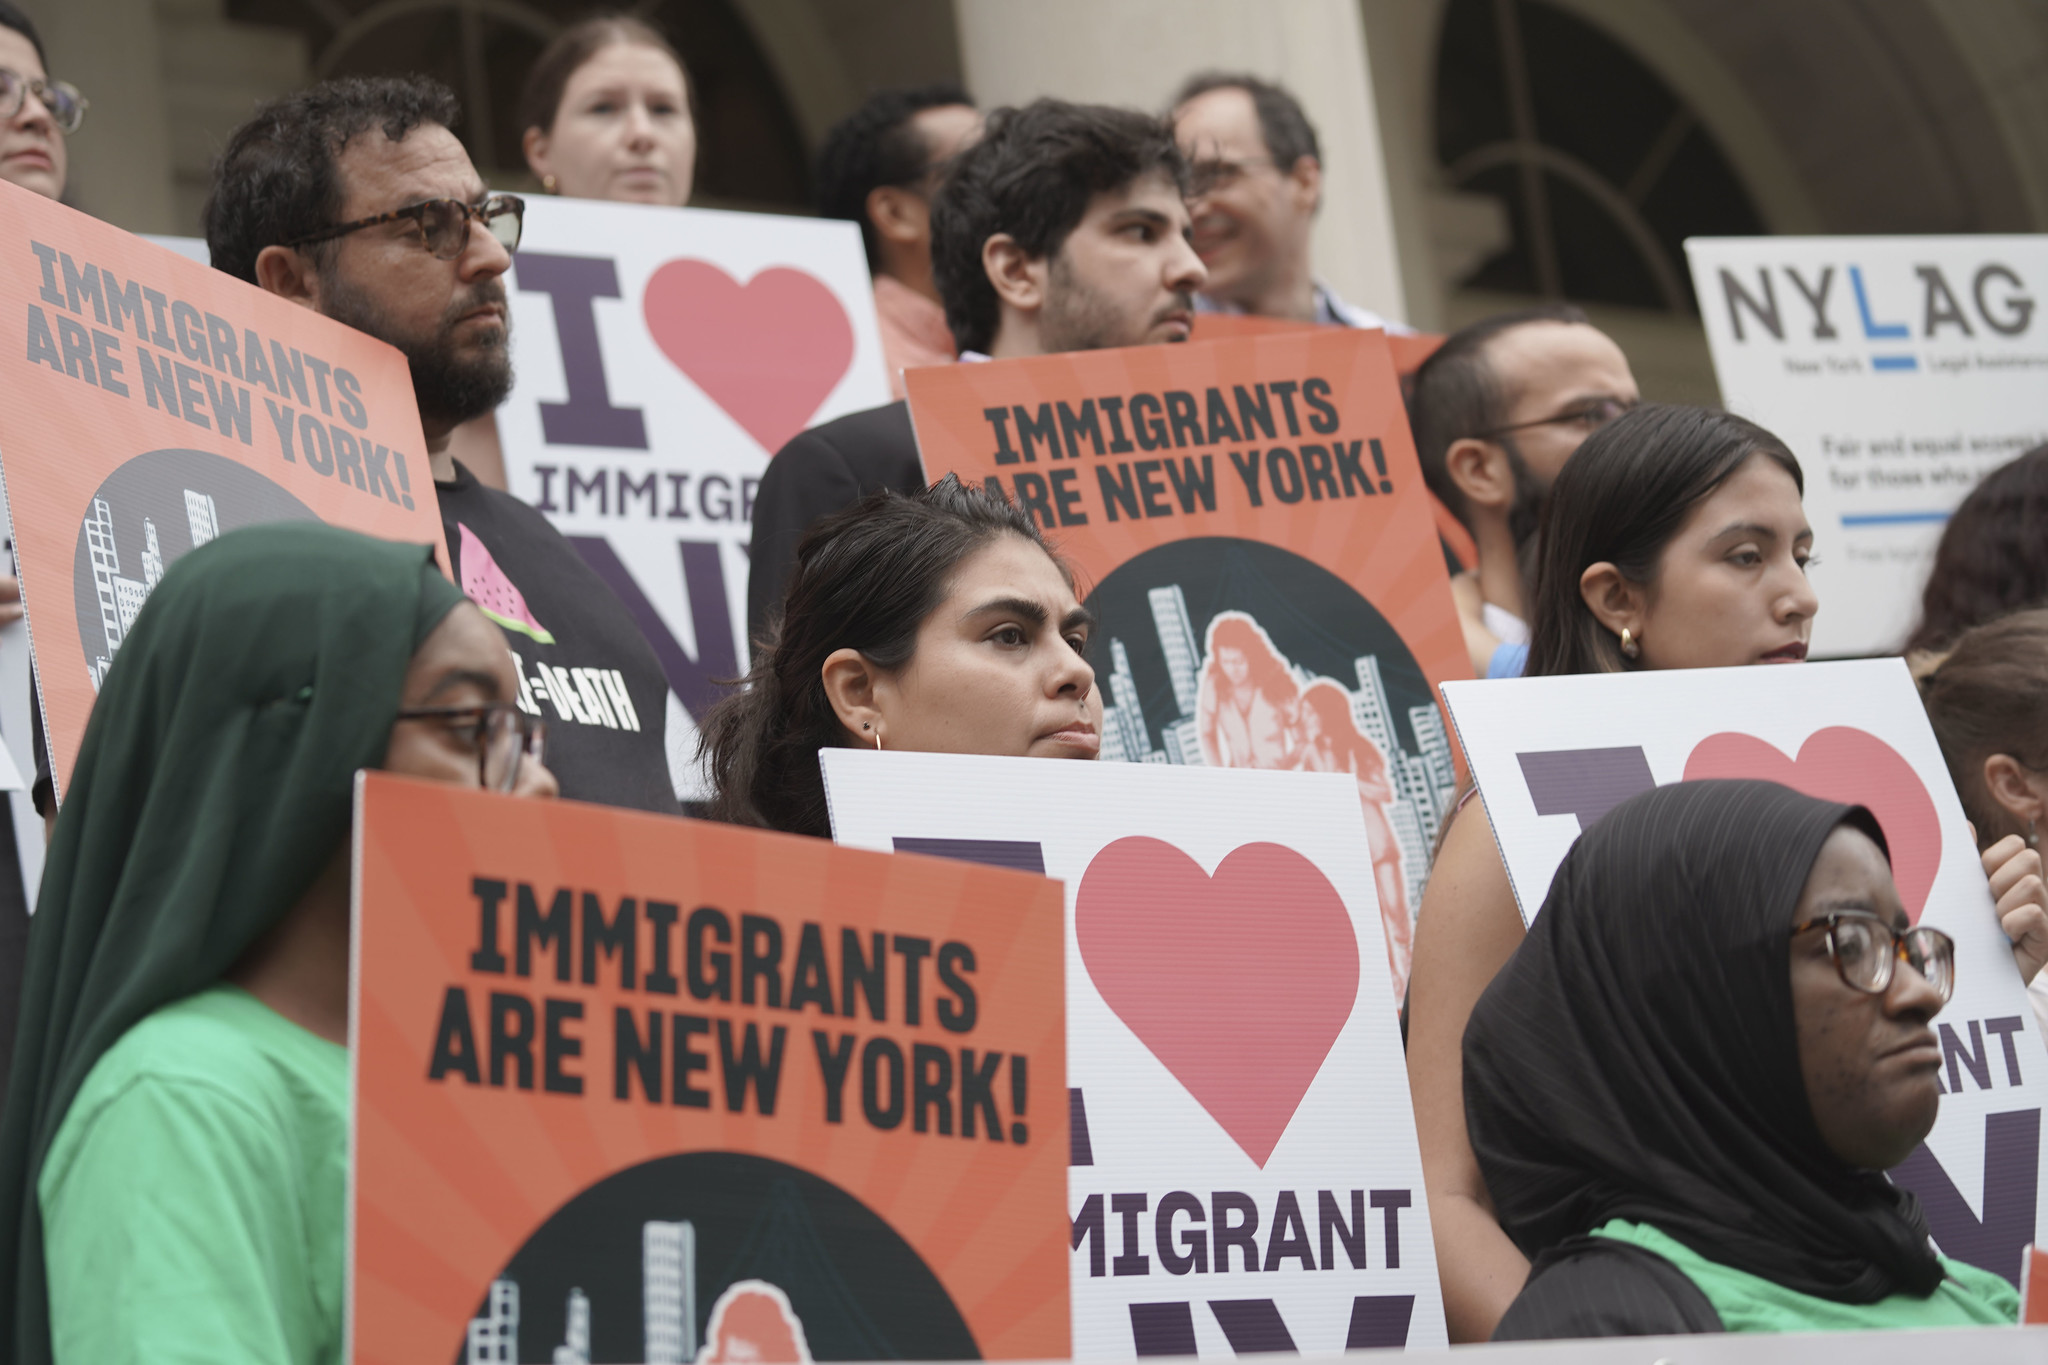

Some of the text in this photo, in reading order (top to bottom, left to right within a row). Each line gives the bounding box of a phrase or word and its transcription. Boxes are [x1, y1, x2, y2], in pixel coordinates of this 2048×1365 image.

[30, 240, 368, 430] IMMIGRANTS
[514, 251, 651, 451] I
[1717, 262, 2036, 343] NYLAG
[26, 304, 417, 512] ARE NEW YORK!
[983, 377, 1340, 466] IMMIGRANTS
[1095, 454, 1219, 523] NEW
[1227, 437, 1394, 508] YORK!
[507, 648, 641, 732] E=DEATH
[470, 874, 980, 1036] IMMIGRANTS
[426, 983, 586, 1098] ARE
[613, 1006, 788, 1120] NEW
[810, 1028, 1030, 1148] YORK!
